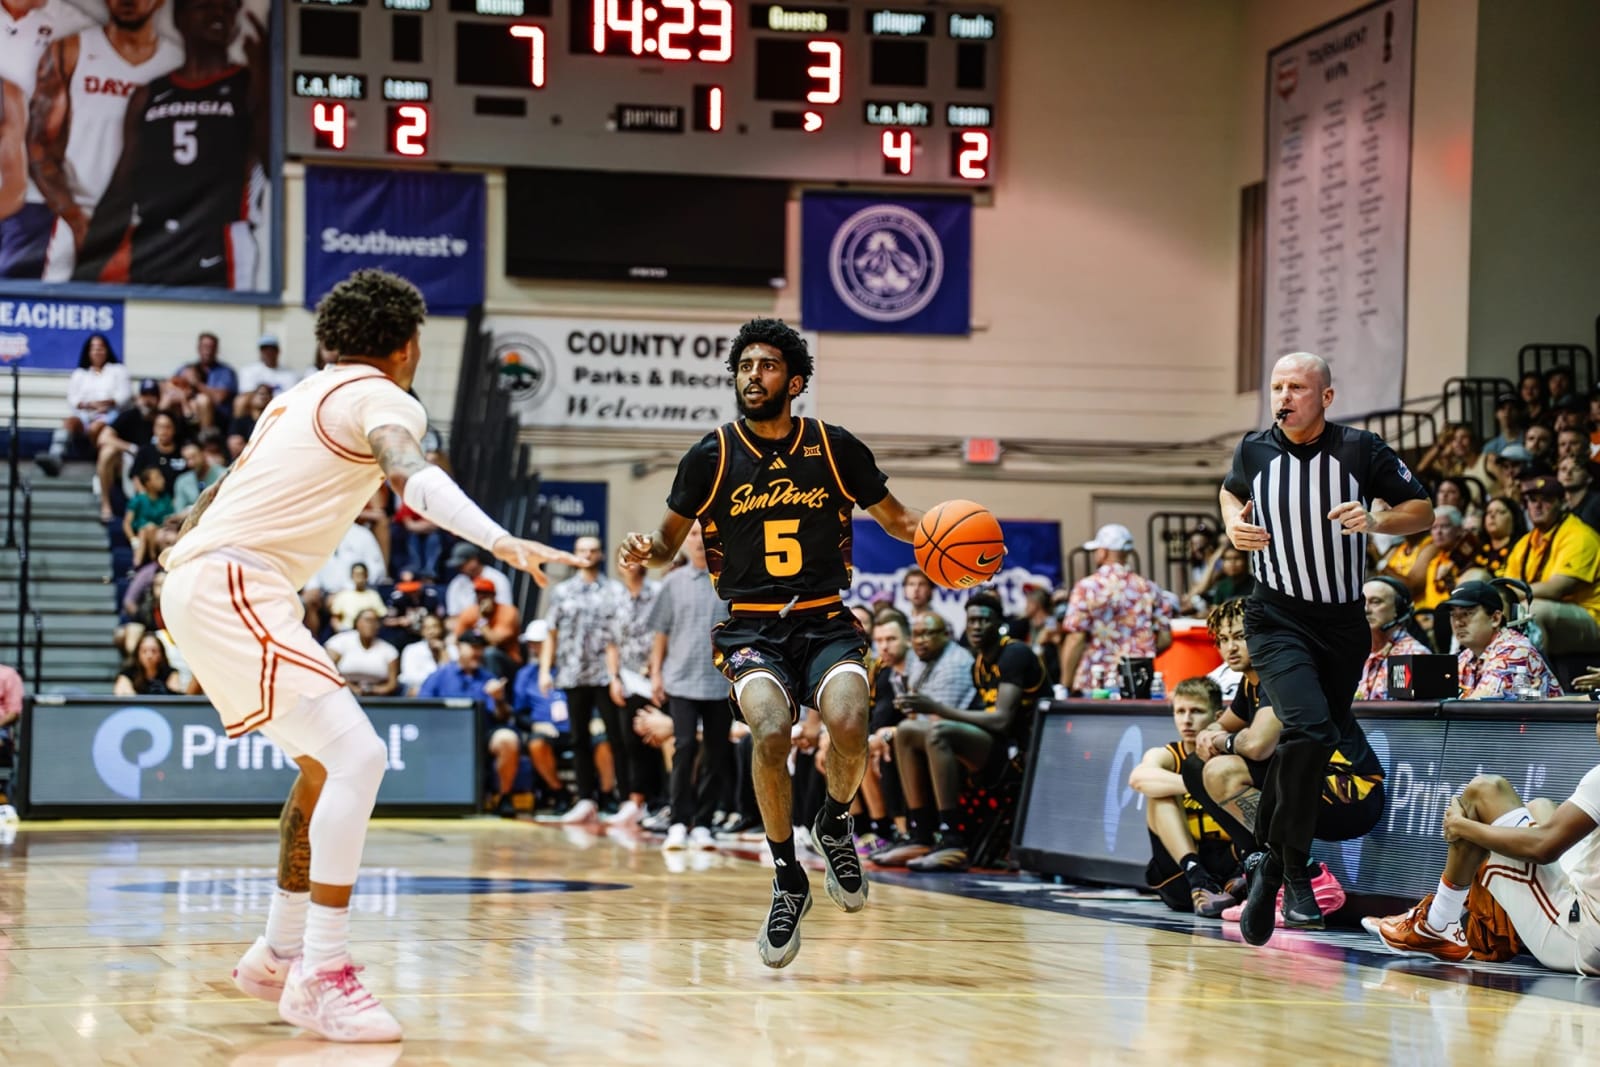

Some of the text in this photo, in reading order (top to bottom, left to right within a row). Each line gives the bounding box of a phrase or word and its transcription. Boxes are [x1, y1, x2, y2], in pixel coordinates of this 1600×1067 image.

[593, 0, 732, 62] 14:23
[768, 5, 828, 31] Guests
[509, 25, 545, 87] 7
[806, 40, 841, 104] 3
[145, 100, 235, 122] GEORGIA
[313, 103, 344, 149] 4
[396, 106, 427, 155] 2
[622, 108, 678, 128] period
[709, 87, 722, 131] 1
[173, 120, 198, 165] 5
[882, 130, 912, 174] 4
[959, 131, 989, 179] 2
[321, 227, 451, 257] Southwest
[567, 332, 729, 358] COUNTY OF
[574, 367, 641, 386] Parks
[650, 369, 664, 386] &
[566, 396, 720, 421] Welcomes
[730, 478, 829, 516] Sun Devils
[763, 518, 803, 578] 5
